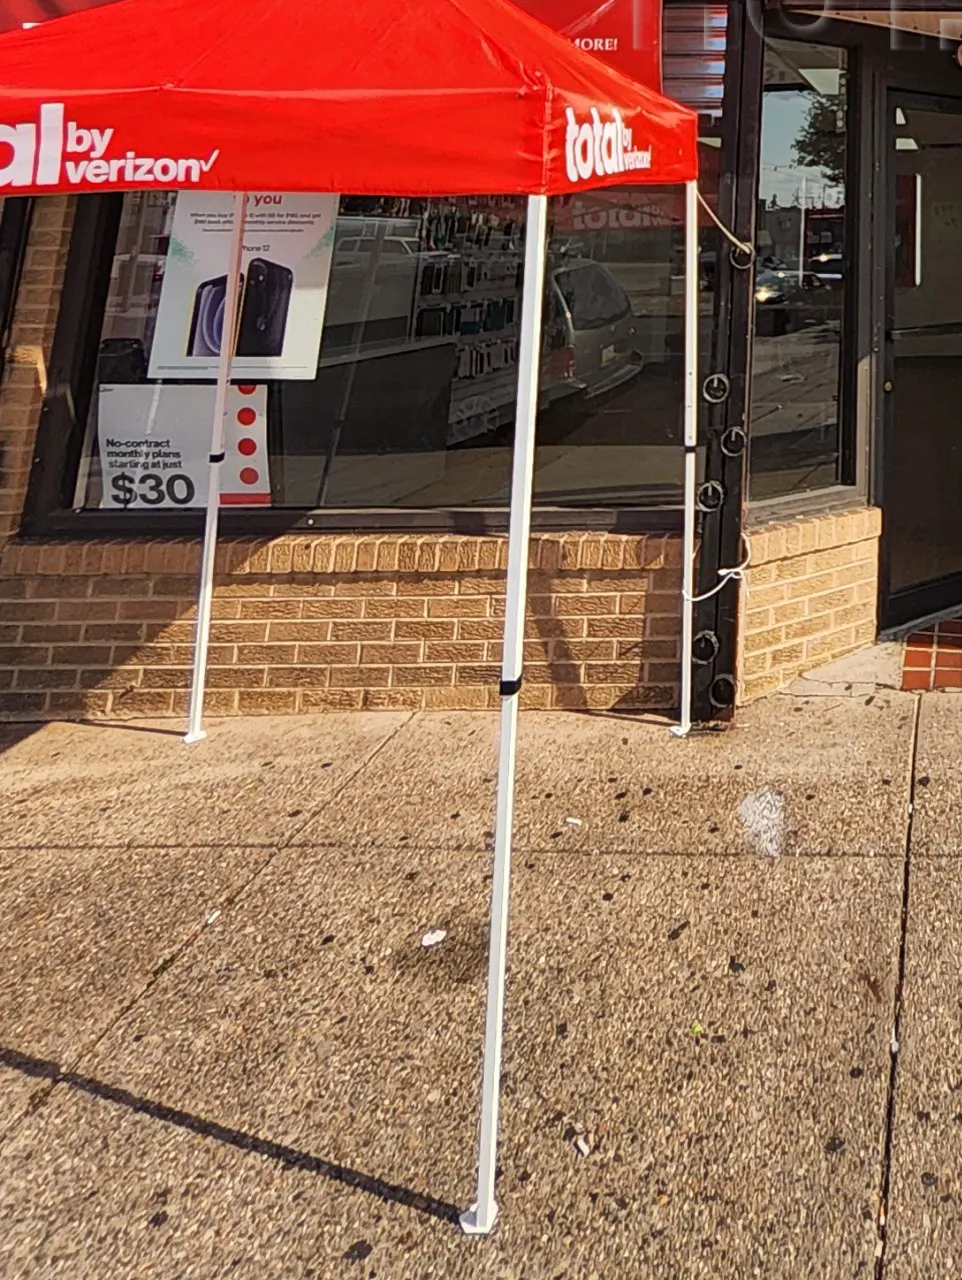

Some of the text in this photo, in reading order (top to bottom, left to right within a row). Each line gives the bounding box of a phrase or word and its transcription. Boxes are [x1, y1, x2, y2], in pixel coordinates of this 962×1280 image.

[66, 121, 114, 158] by
[565, 107, 626, 183] total
[65, 151, 202, 184] verizon
[254, 194, 283, 207] you
[105, 438, 171, 448] No-contract
[152, 449, 182, 459] plans
[162, 460, 183, 470] just
[110, 472, 195, 506] $30
